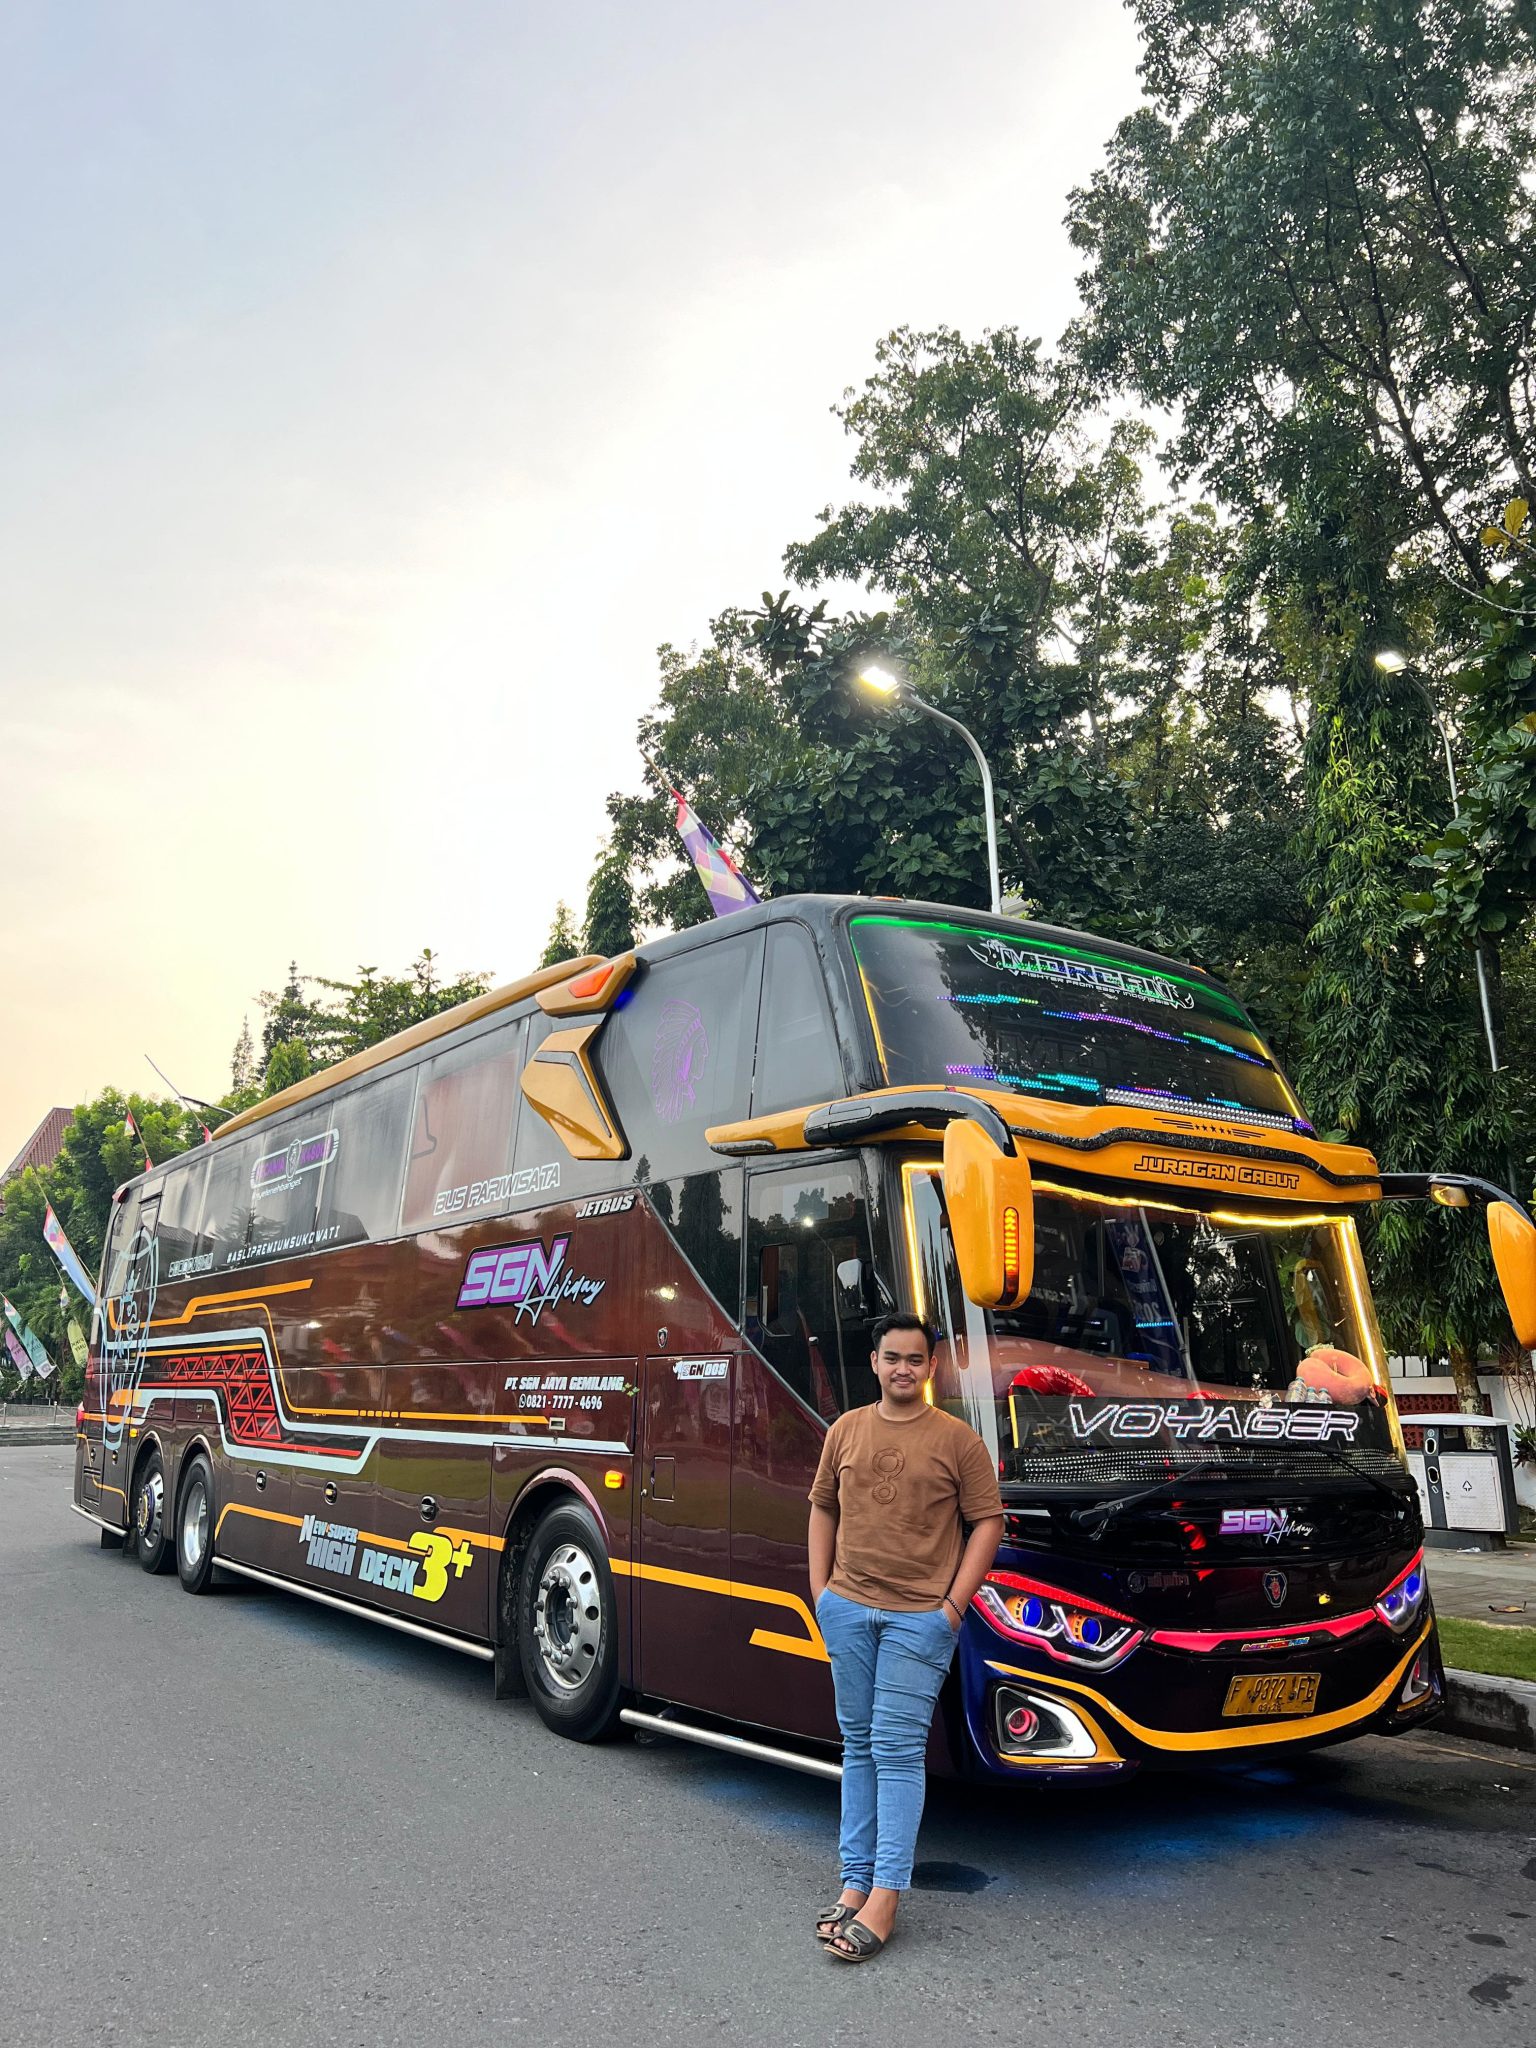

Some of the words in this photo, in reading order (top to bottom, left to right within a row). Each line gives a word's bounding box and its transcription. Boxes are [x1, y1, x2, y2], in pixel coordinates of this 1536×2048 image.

[1020, 971, 1064, 984] FIGHTER
[1065, 978, 1095, 989] FROM
[1134, 1156, 1236, 1182] JURAGAN
[1238, 1167, 1300, 1189] GABUT
[433, 1185, 468, 1217] BUS
[575, 1194, 636, 1220] JETBUS
[456, 1236, 570, 1308] SGN
[514, 1256, 606, 1328] Holiday
[504, 1376, 518, 1391] PT.
[519, 1376, 540, 1391] SGN
[541, 1376, 567, 1391] JAYA
[568, 1376, 625, 1392] GEMILANG
[681, 1364, 704, 1377] SGN
[1068, 1403, 1360, 1442] VOYAGER
[299, 1514, 327, 1543] NEW
[327, 1523, 359, 1544] SUPER
[1219, 1507, 1288, 1534] SGN
[1263, 1514, 1313, 1544] Holiday
[306, 1536, 357, 1576] HIGH
[358, 1548, 420, 1596] DECK
[1229, 1679, 1243, 1702] F
